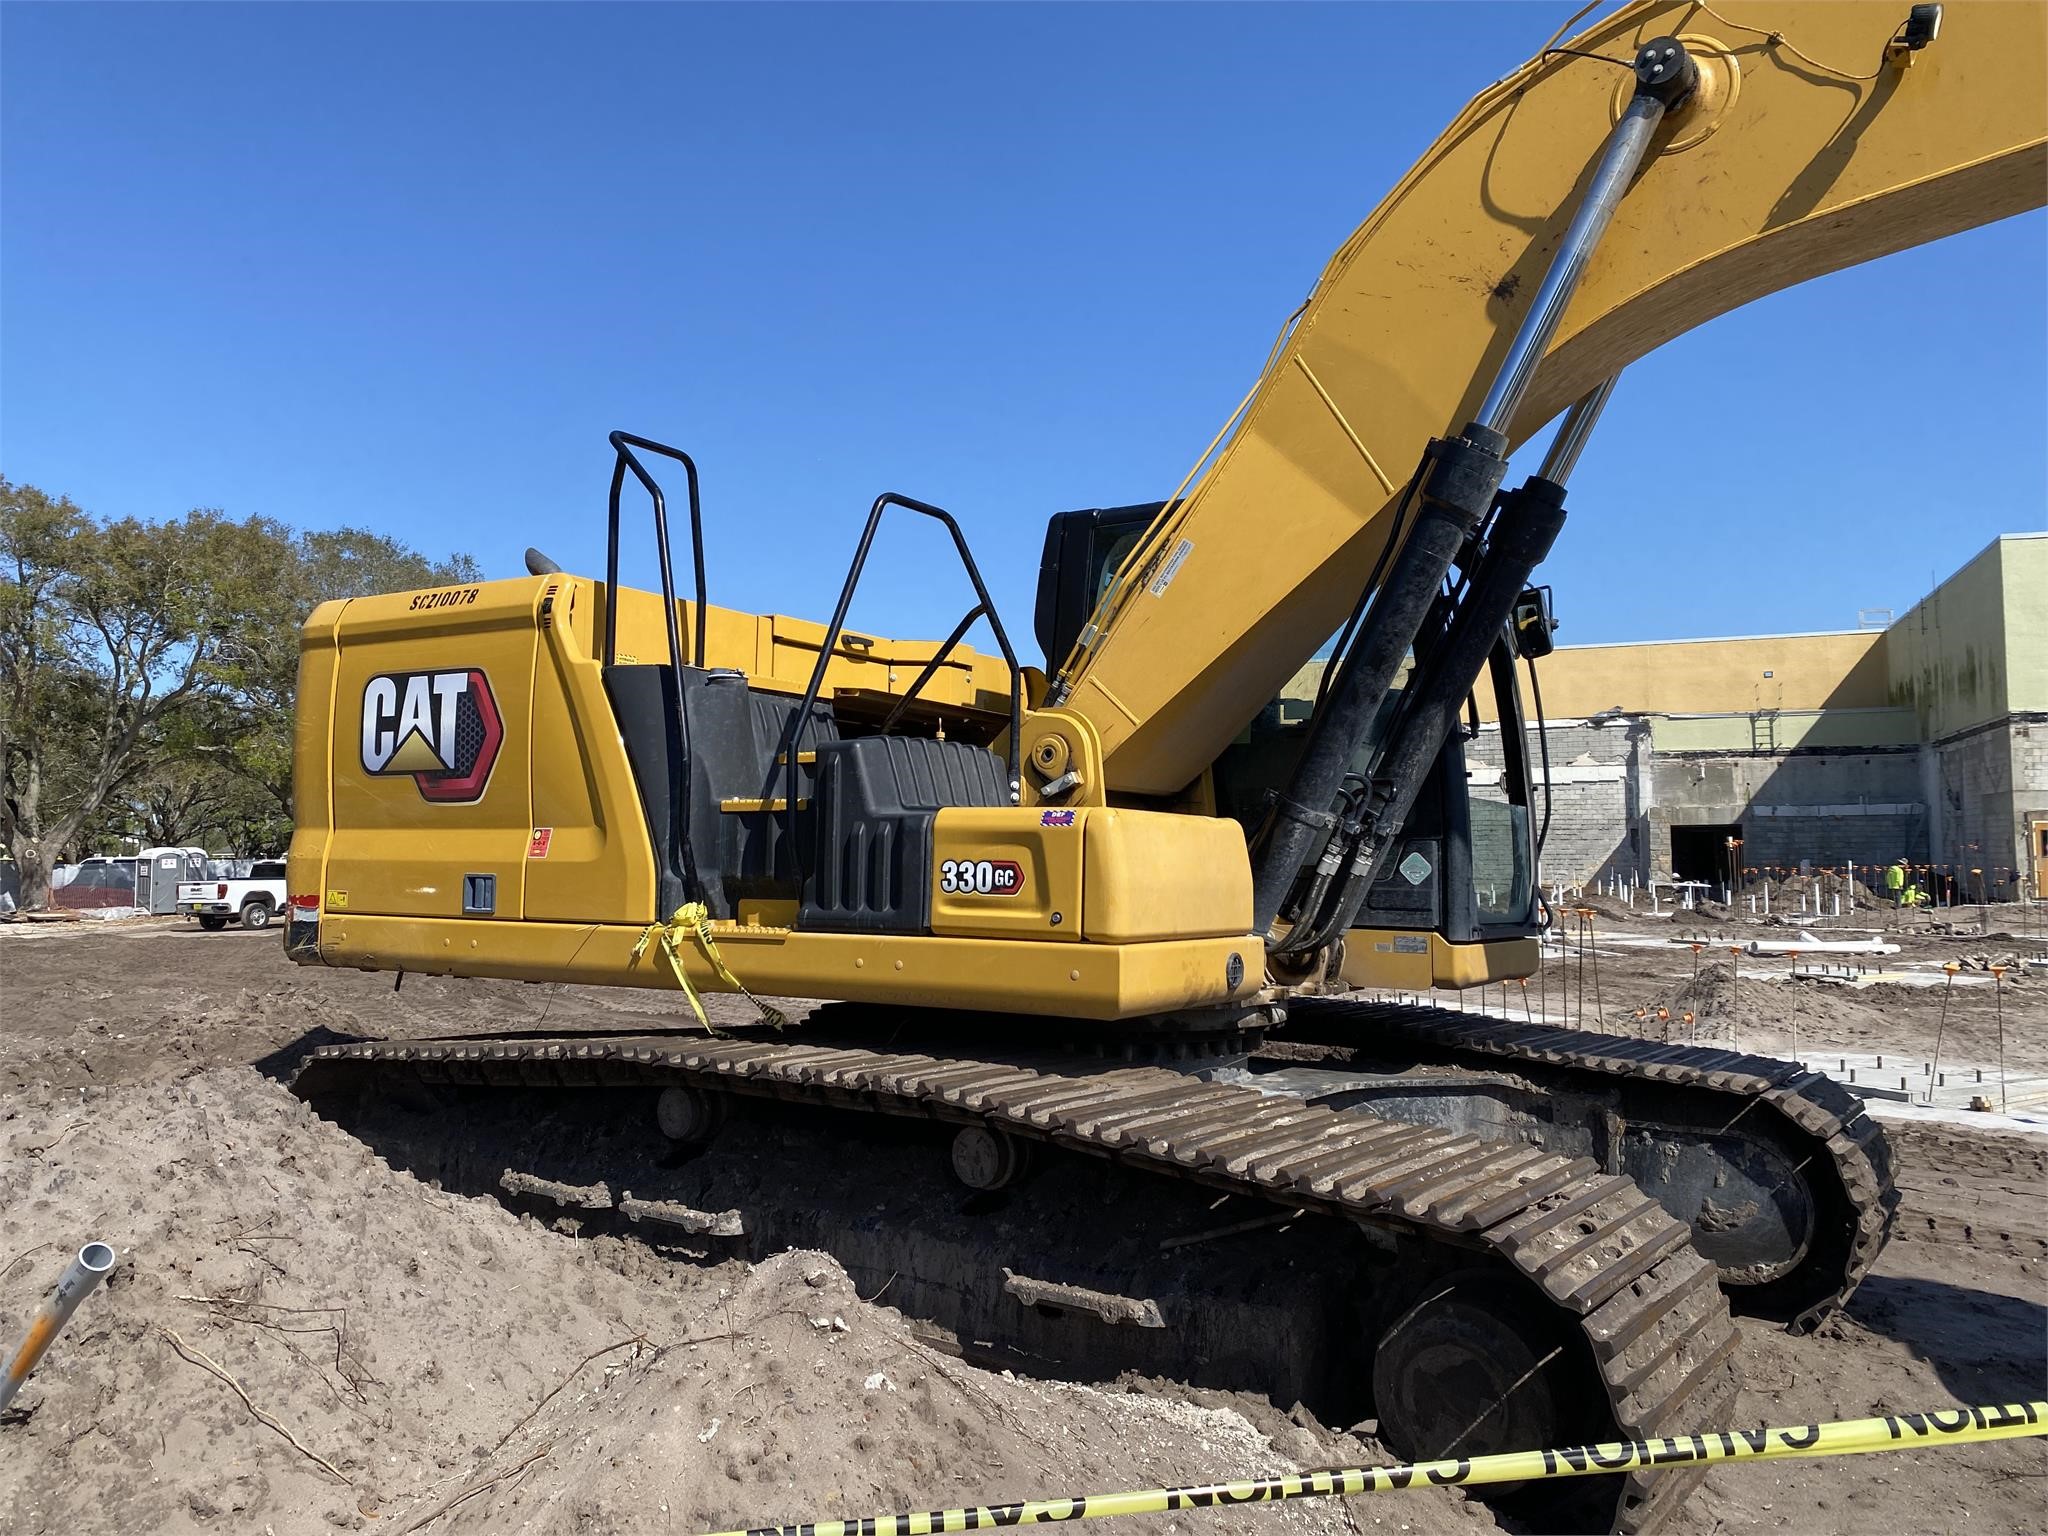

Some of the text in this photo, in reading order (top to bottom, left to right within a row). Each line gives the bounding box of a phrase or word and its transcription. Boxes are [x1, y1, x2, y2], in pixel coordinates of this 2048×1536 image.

[362, 672, 469, 772] CAT
[941, 860, 1014, 893] 330 GC
